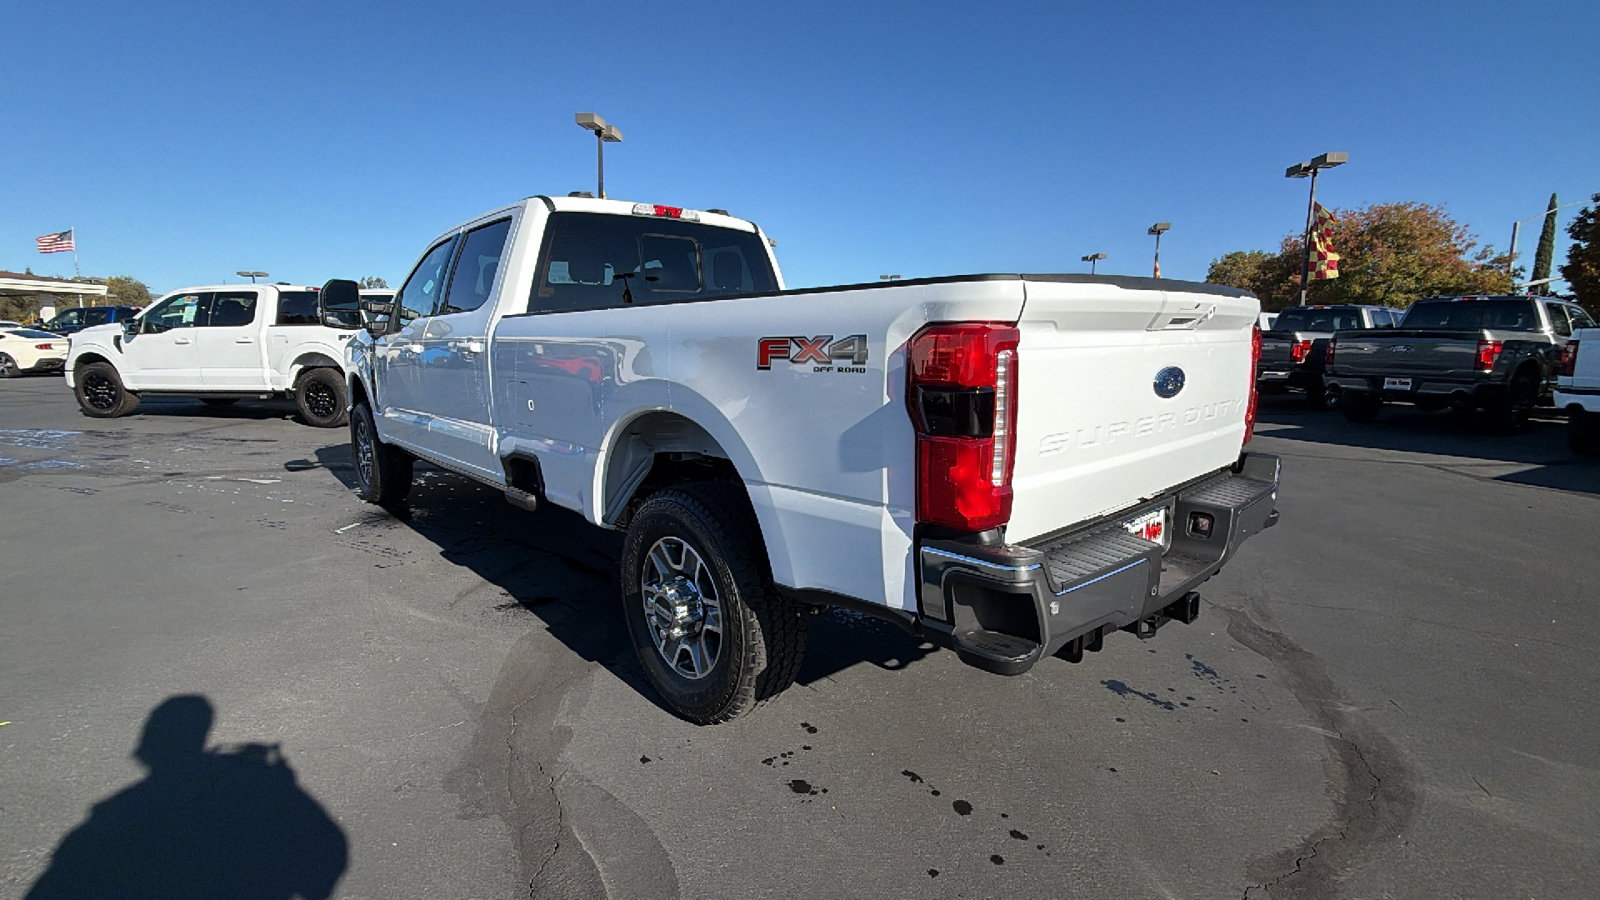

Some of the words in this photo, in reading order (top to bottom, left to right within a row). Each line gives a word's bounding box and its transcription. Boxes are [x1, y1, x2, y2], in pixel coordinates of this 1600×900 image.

[757, 335, 868, 370] FX4
[1039, 412, 1176, 457] SUPER
[1184, 399, 1243, 426] DUTY
